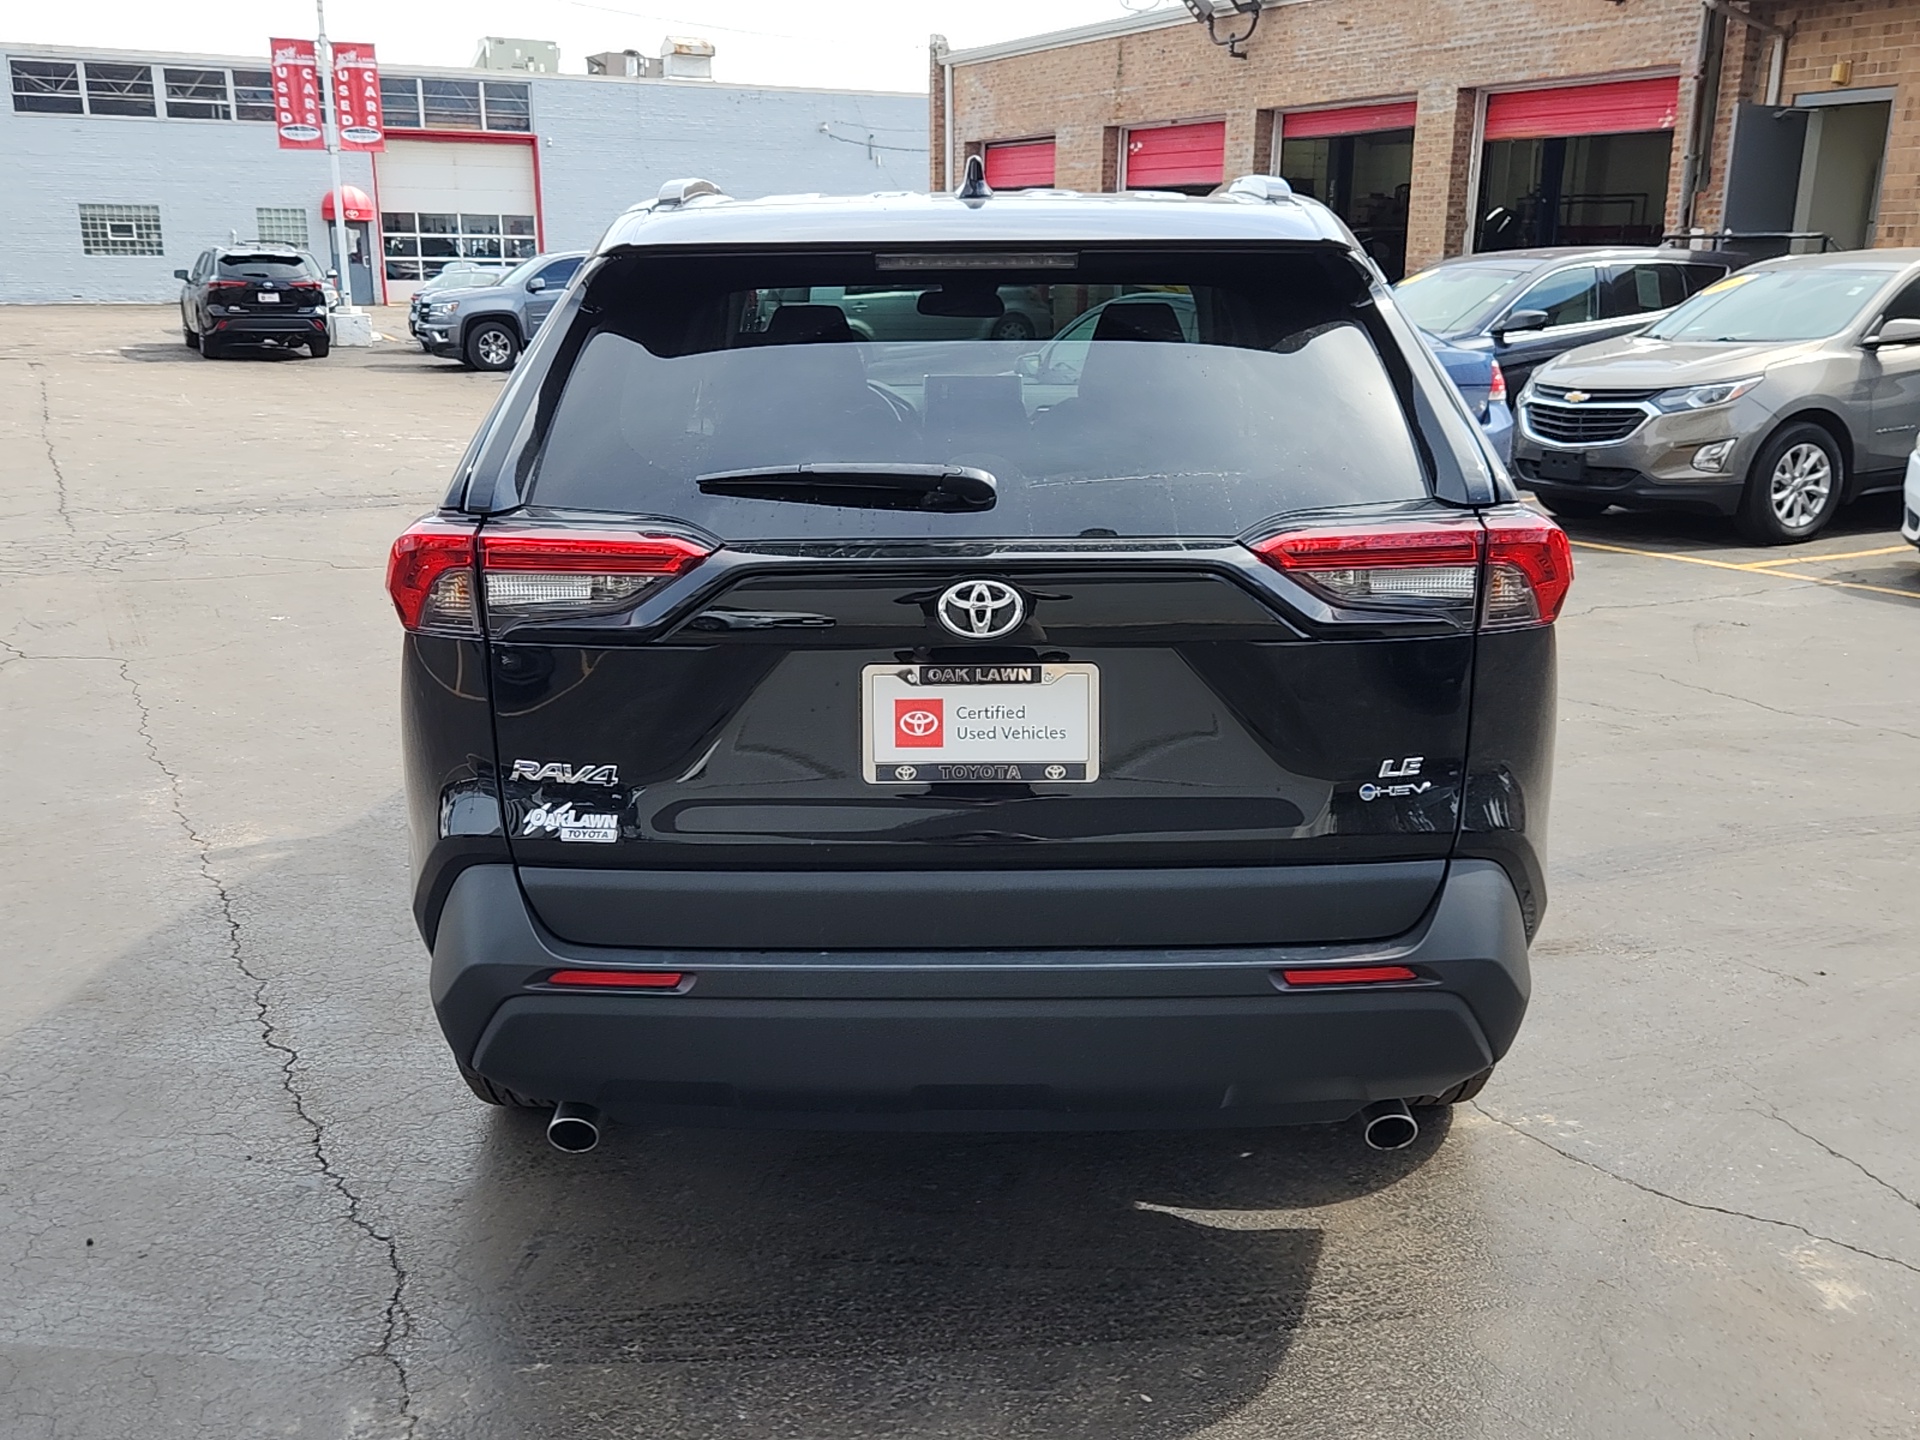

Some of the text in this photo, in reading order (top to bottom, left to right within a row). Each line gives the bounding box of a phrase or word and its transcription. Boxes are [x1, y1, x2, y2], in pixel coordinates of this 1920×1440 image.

[276, 66, 293, 123] USED
[302, 68, 317, 124] CARS
[337, 70, 354, 126] USED
[363, 71, 378, 127] CARS
[927, 668, 1032, 682] OAK LAWN
[956, 706, 1026, 720] Certified
[957, 726, 1067, 740] Used Vehicles
[509, 759, 619, 787] RAV4
[938, 765, 1022, 780] TOYOTA
[1378, 757, 1424, 778] LE
[567, 830, 609, 839] TOYOTA
